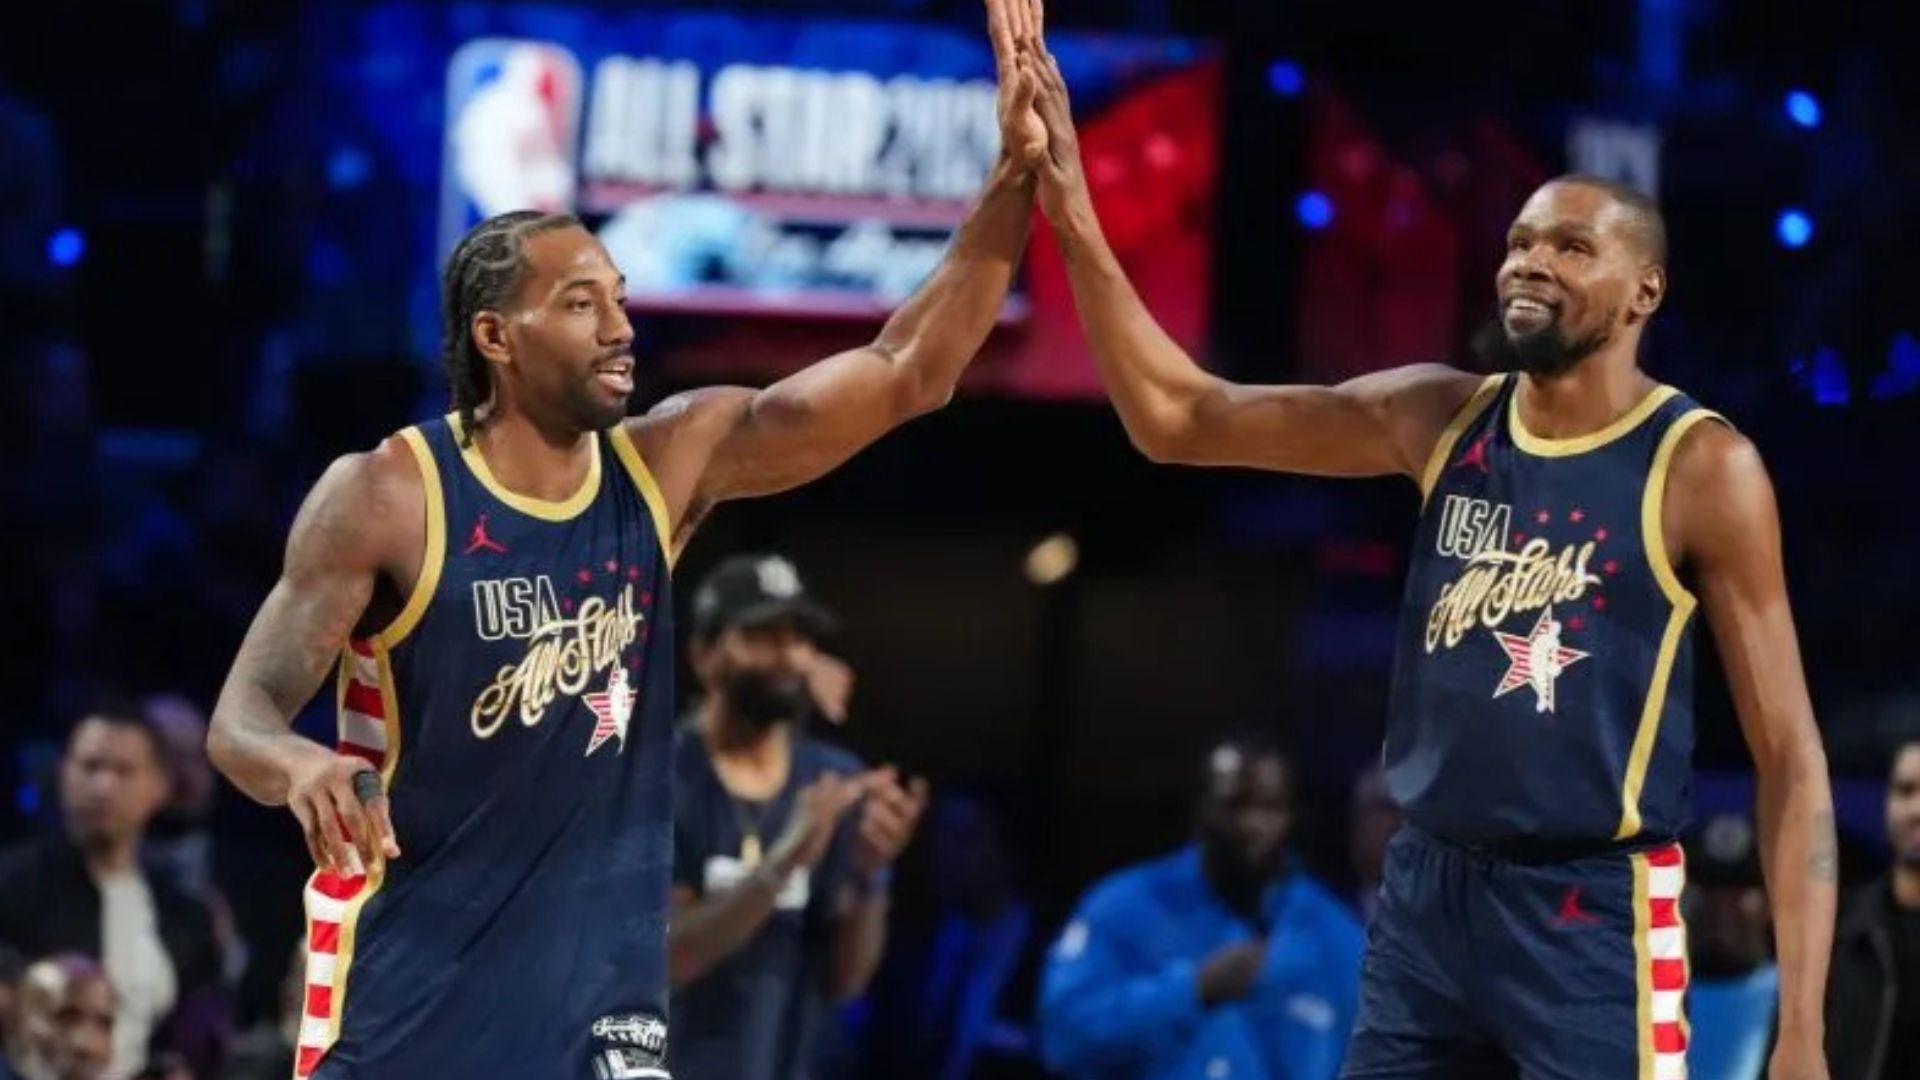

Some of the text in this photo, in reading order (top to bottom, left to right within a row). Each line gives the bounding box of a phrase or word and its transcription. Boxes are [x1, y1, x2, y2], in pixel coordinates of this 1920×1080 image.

[1436, 495, 1512, 559] USA
[473, 575, 562, 640] USA
[1482, 539, 1602, 628] Stars
